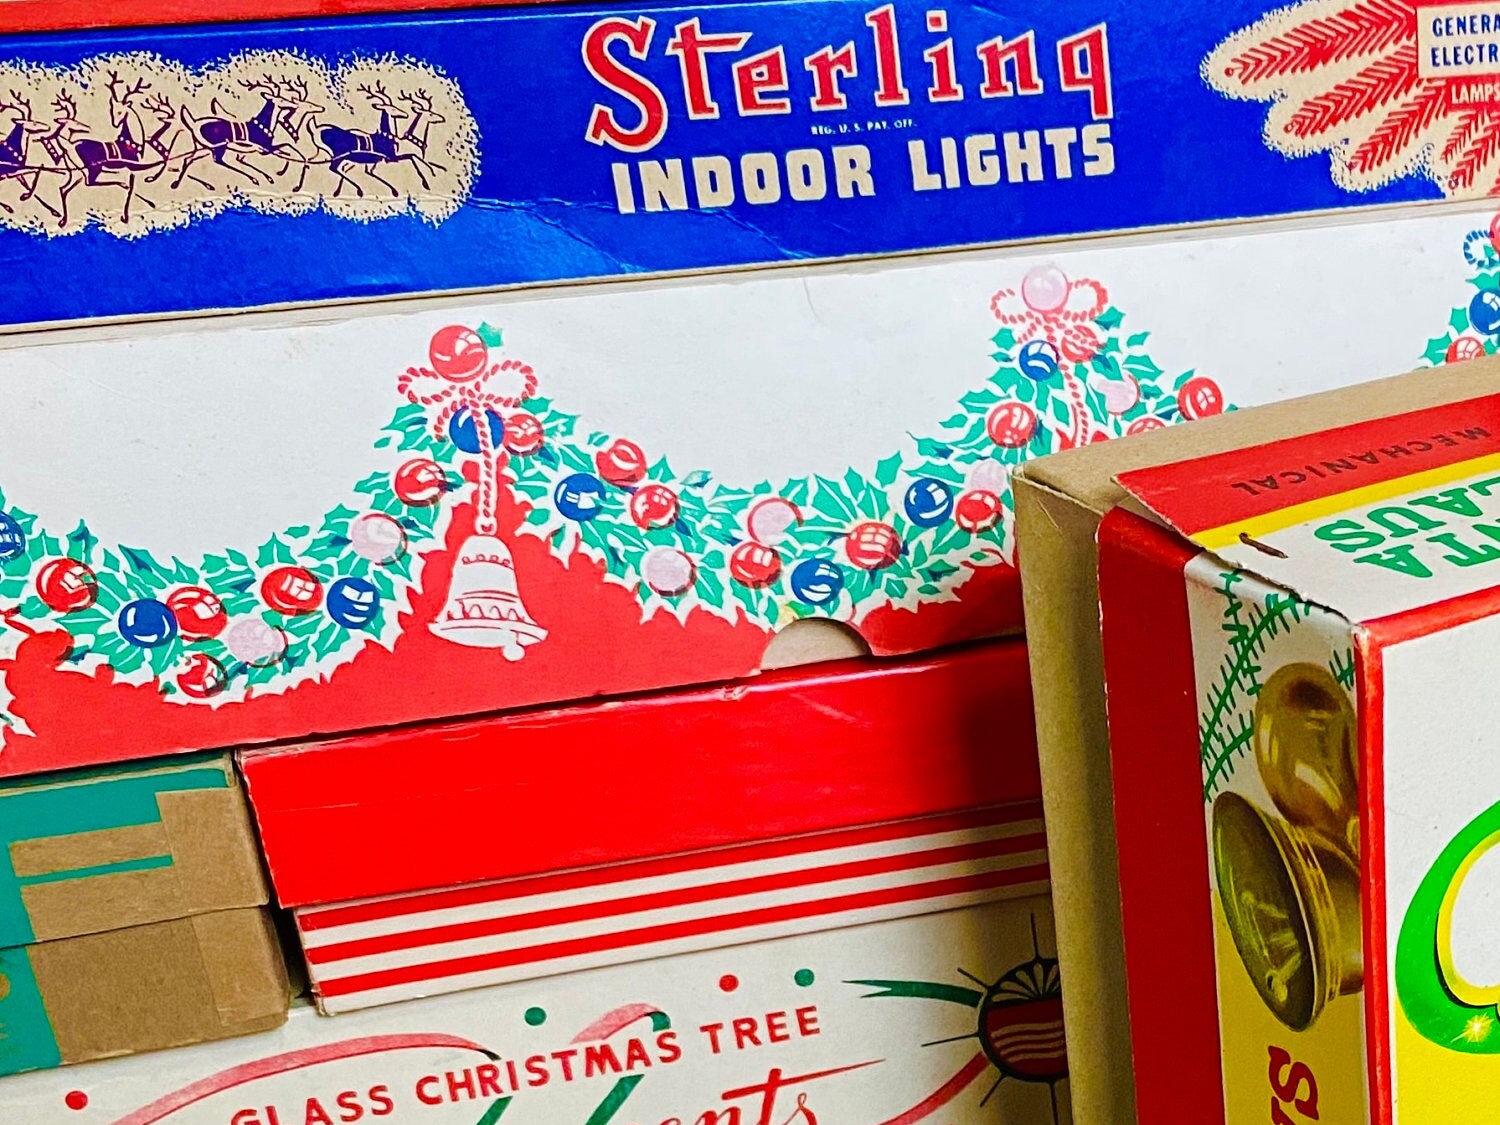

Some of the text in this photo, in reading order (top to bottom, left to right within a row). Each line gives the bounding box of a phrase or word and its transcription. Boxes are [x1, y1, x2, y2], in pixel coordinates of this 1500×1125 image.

[581, 3, 1113, 153] Sterling
[612, 124, 1115, 214] INDOOR LIGHTS
[1230, 426, 1493, 497] MECHANICAL
[416, 1031, 683, 1106] CHRISTMAS
[700, 1005, 822, 1055] TREE
